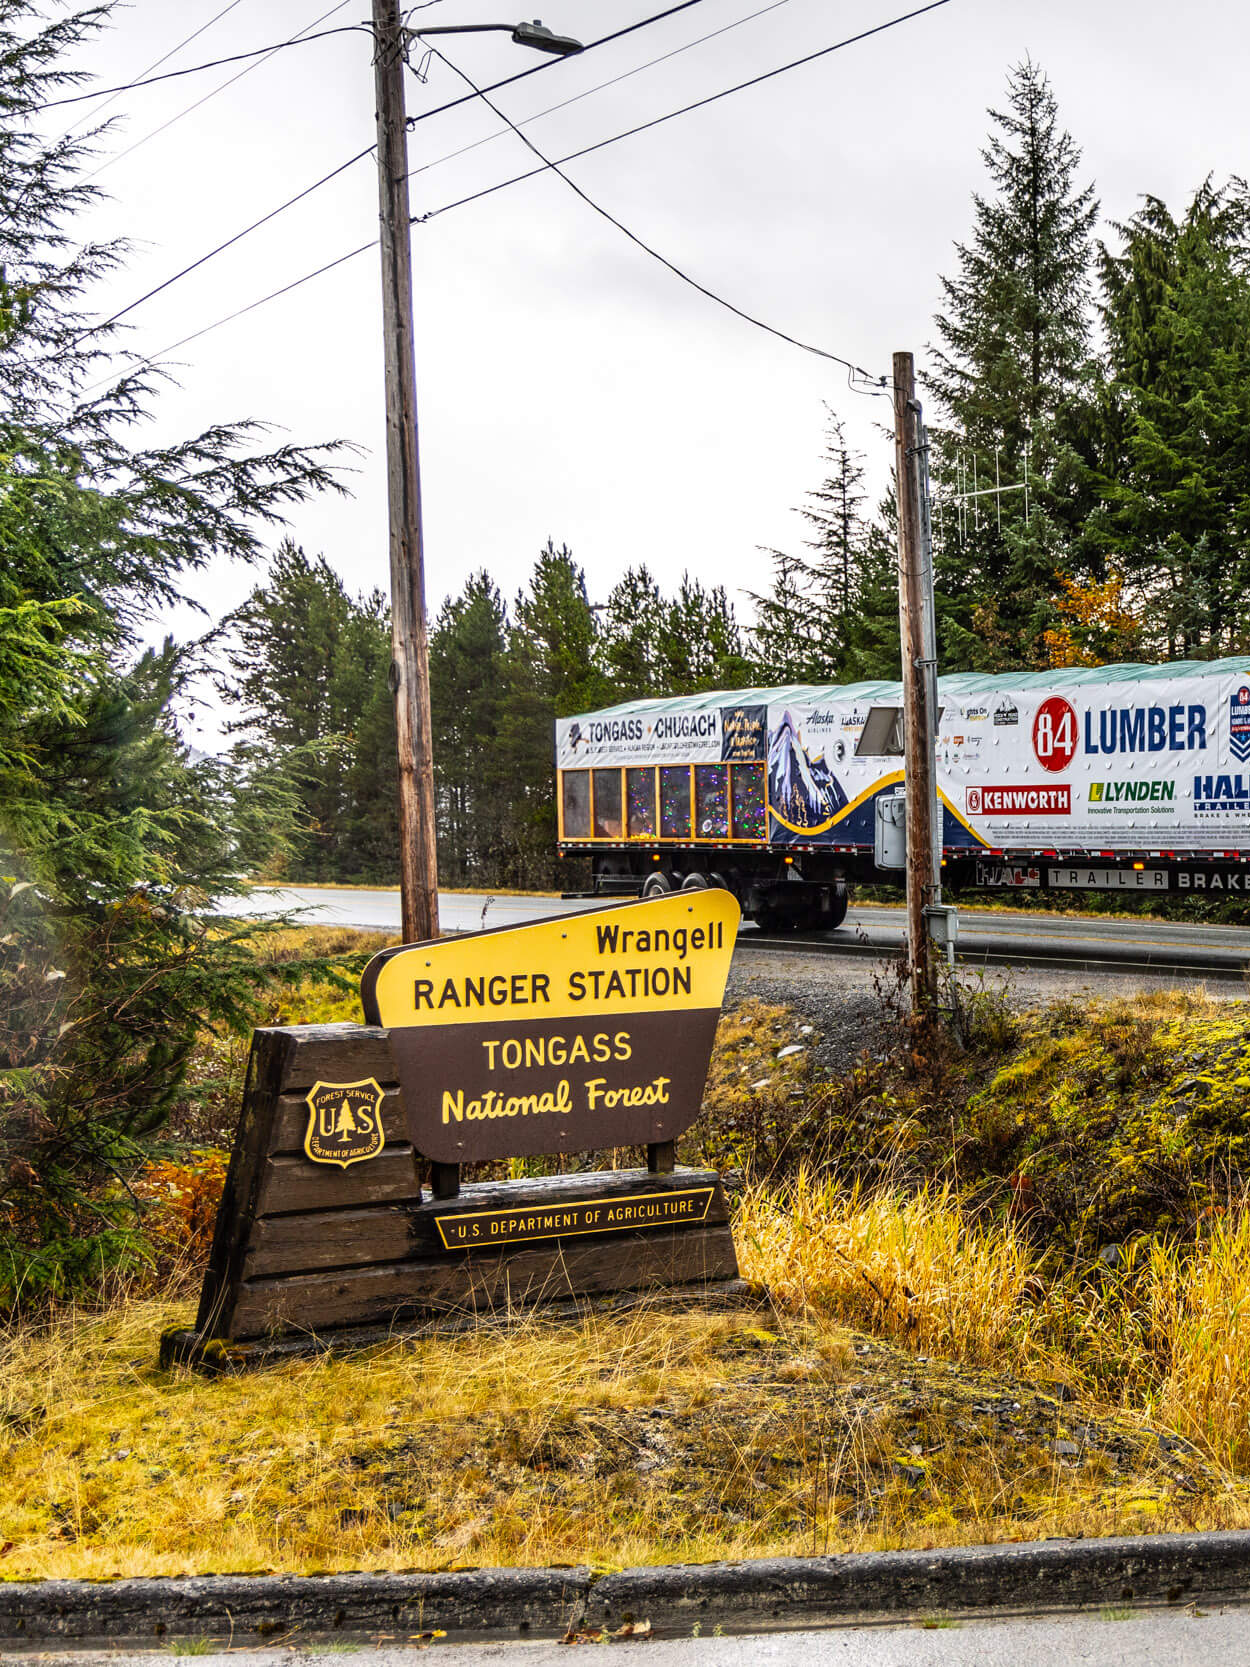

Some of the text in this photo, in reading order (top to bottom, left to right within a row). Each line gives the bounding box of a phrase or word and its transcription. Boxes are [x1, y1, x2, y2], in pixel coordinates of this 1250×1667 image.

[589, 719, 643, 743] TONGASS
[655, 714, 716, 738] CHUGACH
[806, 710, 834, 725] Alaska
[1037, 704, 1208, 757] 84 LUMBER
[984, 790, 1068, 809] KENWORTH
[1105, 780, 1175, 801] LYNDEN
[1088, 805, 1175, 815] Innovative Transportation Solutions
[1052, 870, 1164, 886] TRAILER
[596, 921, 723, 960] Wrangell
[414, 966, 692, 1010] RANGER STATION
[482, 1031, 632, 1070] TONGASS
[316, 1089, 376, 1107] FOREST SERVICE
[442, 1076, 671, 1124] National Forest
[311, 1132, 379, 1158] DEPARTMENT OF AGRICULTURE
[457, 1199, 694, 1239] U.S. DEPARTMENT OF AGRICULTURE
